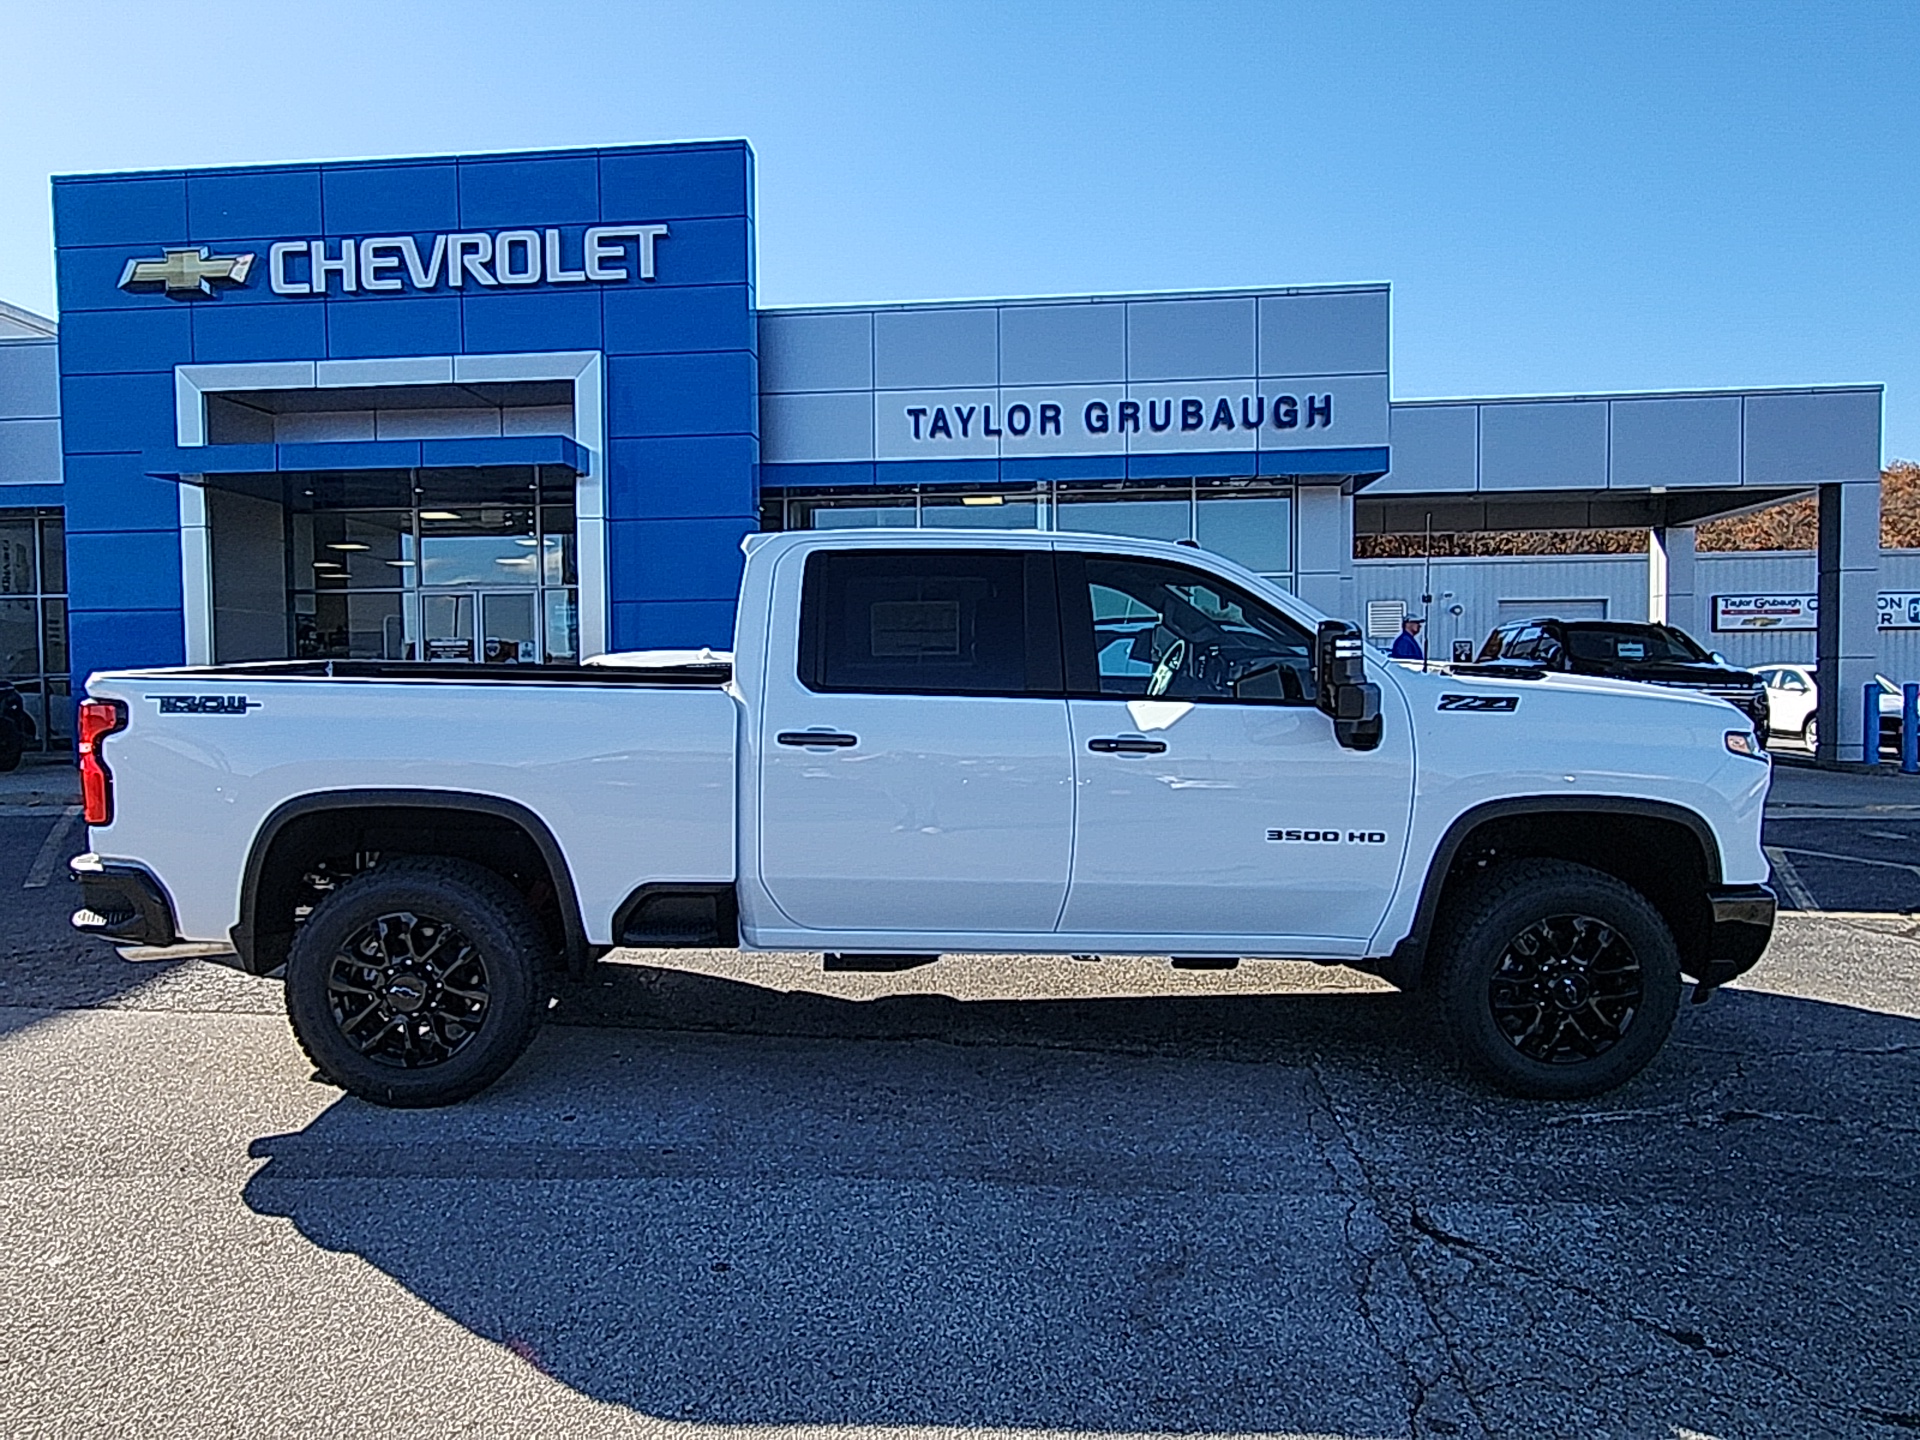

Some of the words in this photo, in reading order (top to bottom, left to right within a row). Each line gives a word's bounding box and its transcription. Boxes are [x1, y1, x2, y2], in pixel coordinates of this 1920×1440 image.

[269, 223, 669, 295] CHEVROLET
[907, 403, 1062, 440] TAYLOR
[1085, 394, 1333, 434] GRUBAUGH
[1722, 598, 1752, 609] Taylor
[1267, 830, 1339, 842] 3500
[1349, 832, 1385, 843] HD
